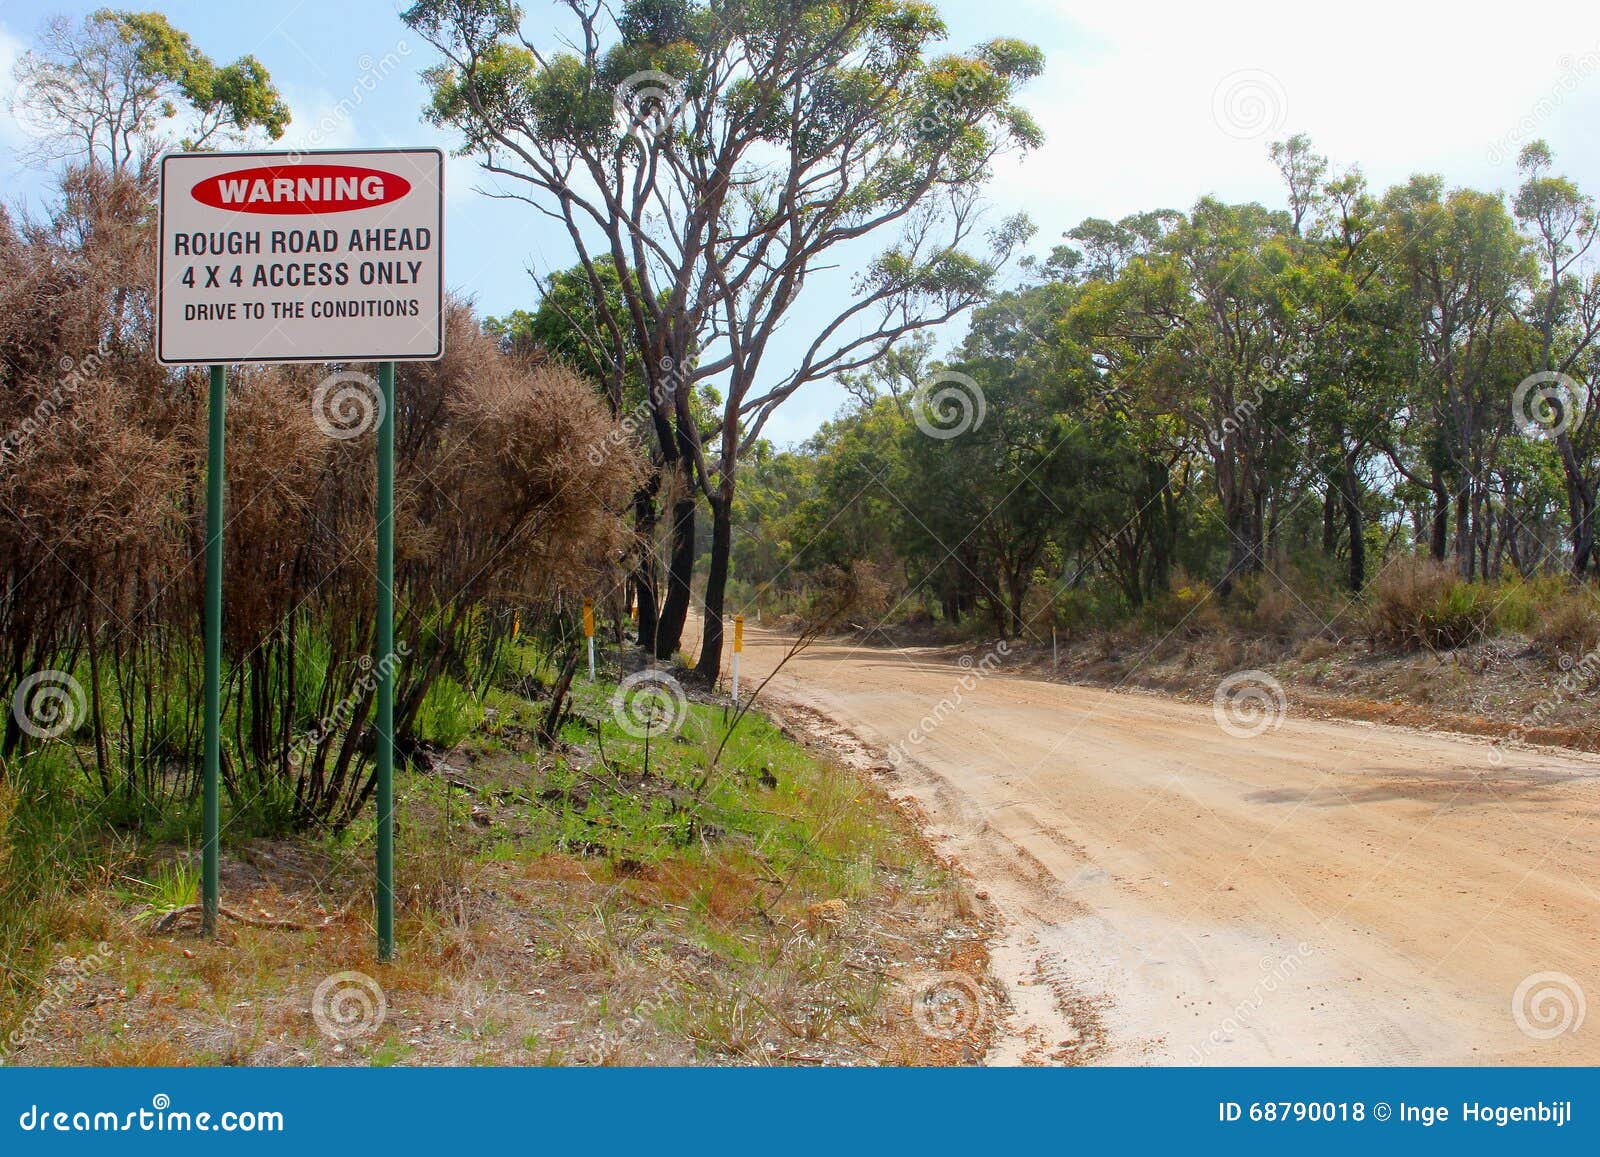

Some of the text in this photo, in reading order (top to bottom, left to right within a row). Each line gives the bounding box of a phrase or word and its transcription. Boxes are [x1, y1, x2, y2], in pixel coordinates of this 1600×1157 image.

[218, 175, 385, 204] WARNING
[175, 228, 431, 256] ROUGH ROAD AHEAD
[182, 260, 422, 289] 4 X 4 ACCESS ONLY
[185, 299, 419, 321] DRIVE TO THE CONDITIONS
